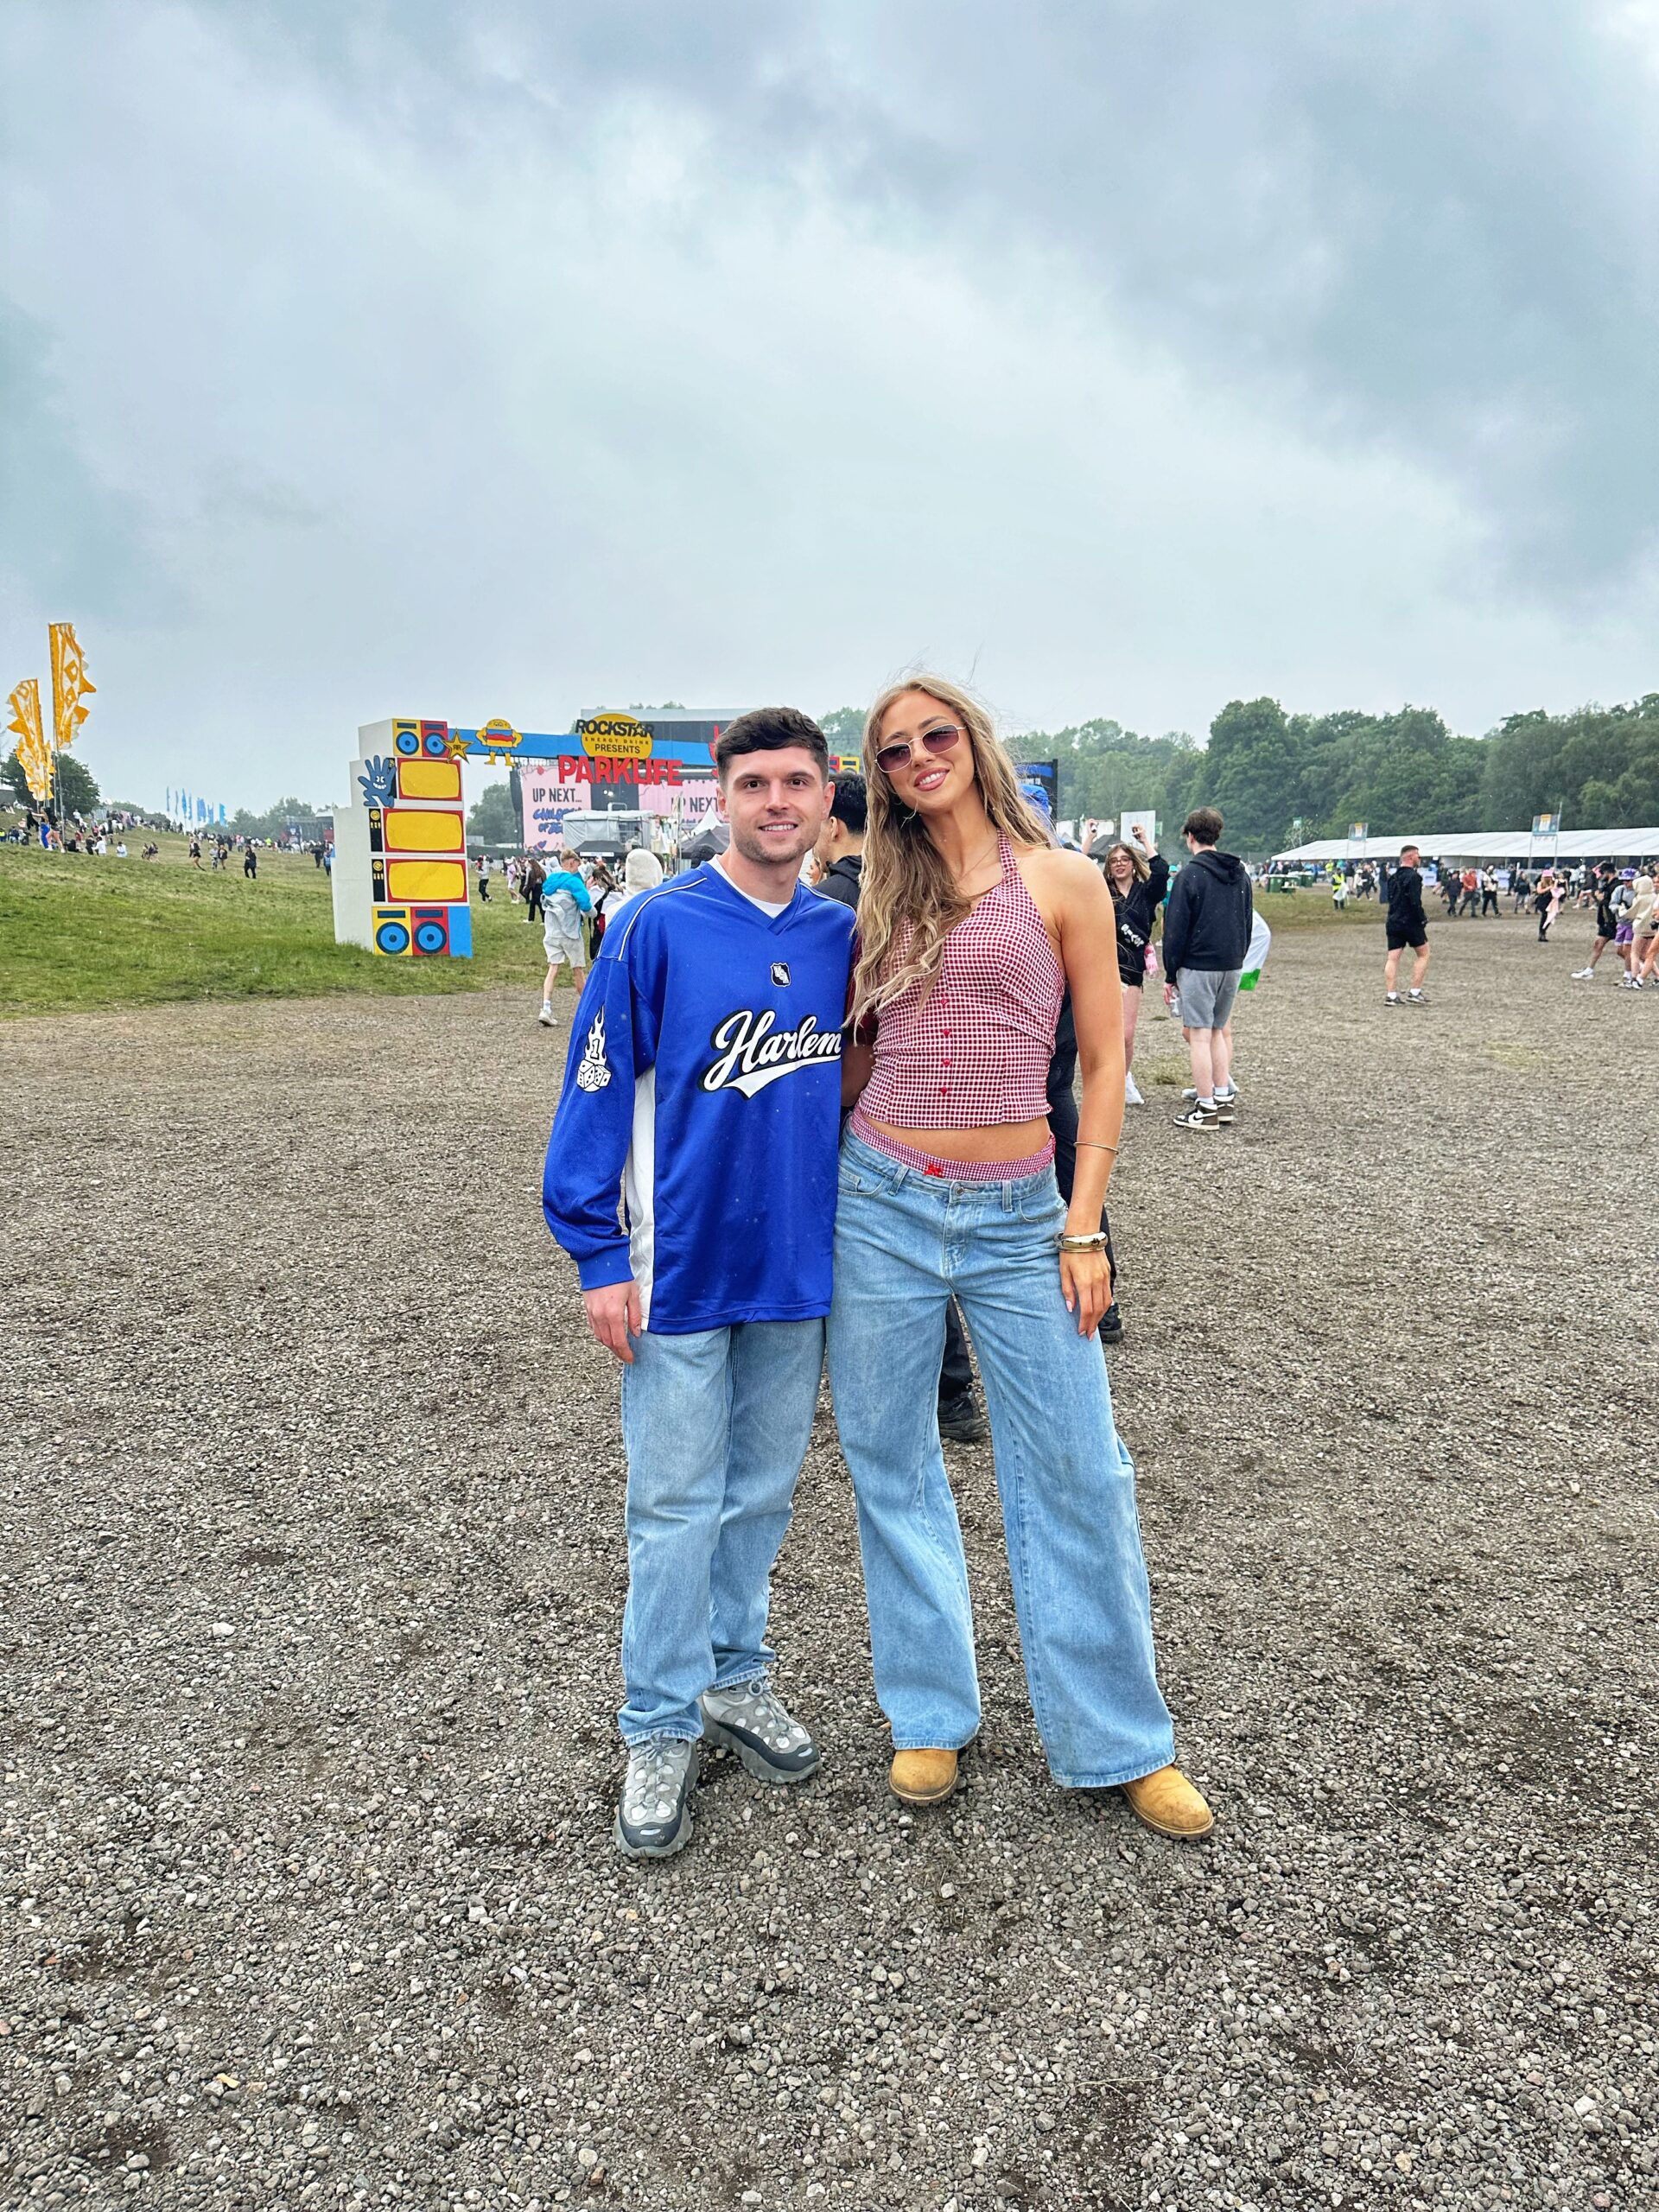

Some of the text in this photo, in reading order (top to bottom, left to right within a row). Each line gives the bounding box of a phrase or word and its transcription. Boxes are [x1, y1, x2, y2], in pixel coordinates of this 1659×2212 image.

[575, 719, 654, 739] ROCKSTAR
[594, 743, 640, 754] PRESENTS
[557, 754, 683, 786] PARKLIFE
[532, 788, 546, 802] UP
[703, 1009, 842, 1091] Harlem
